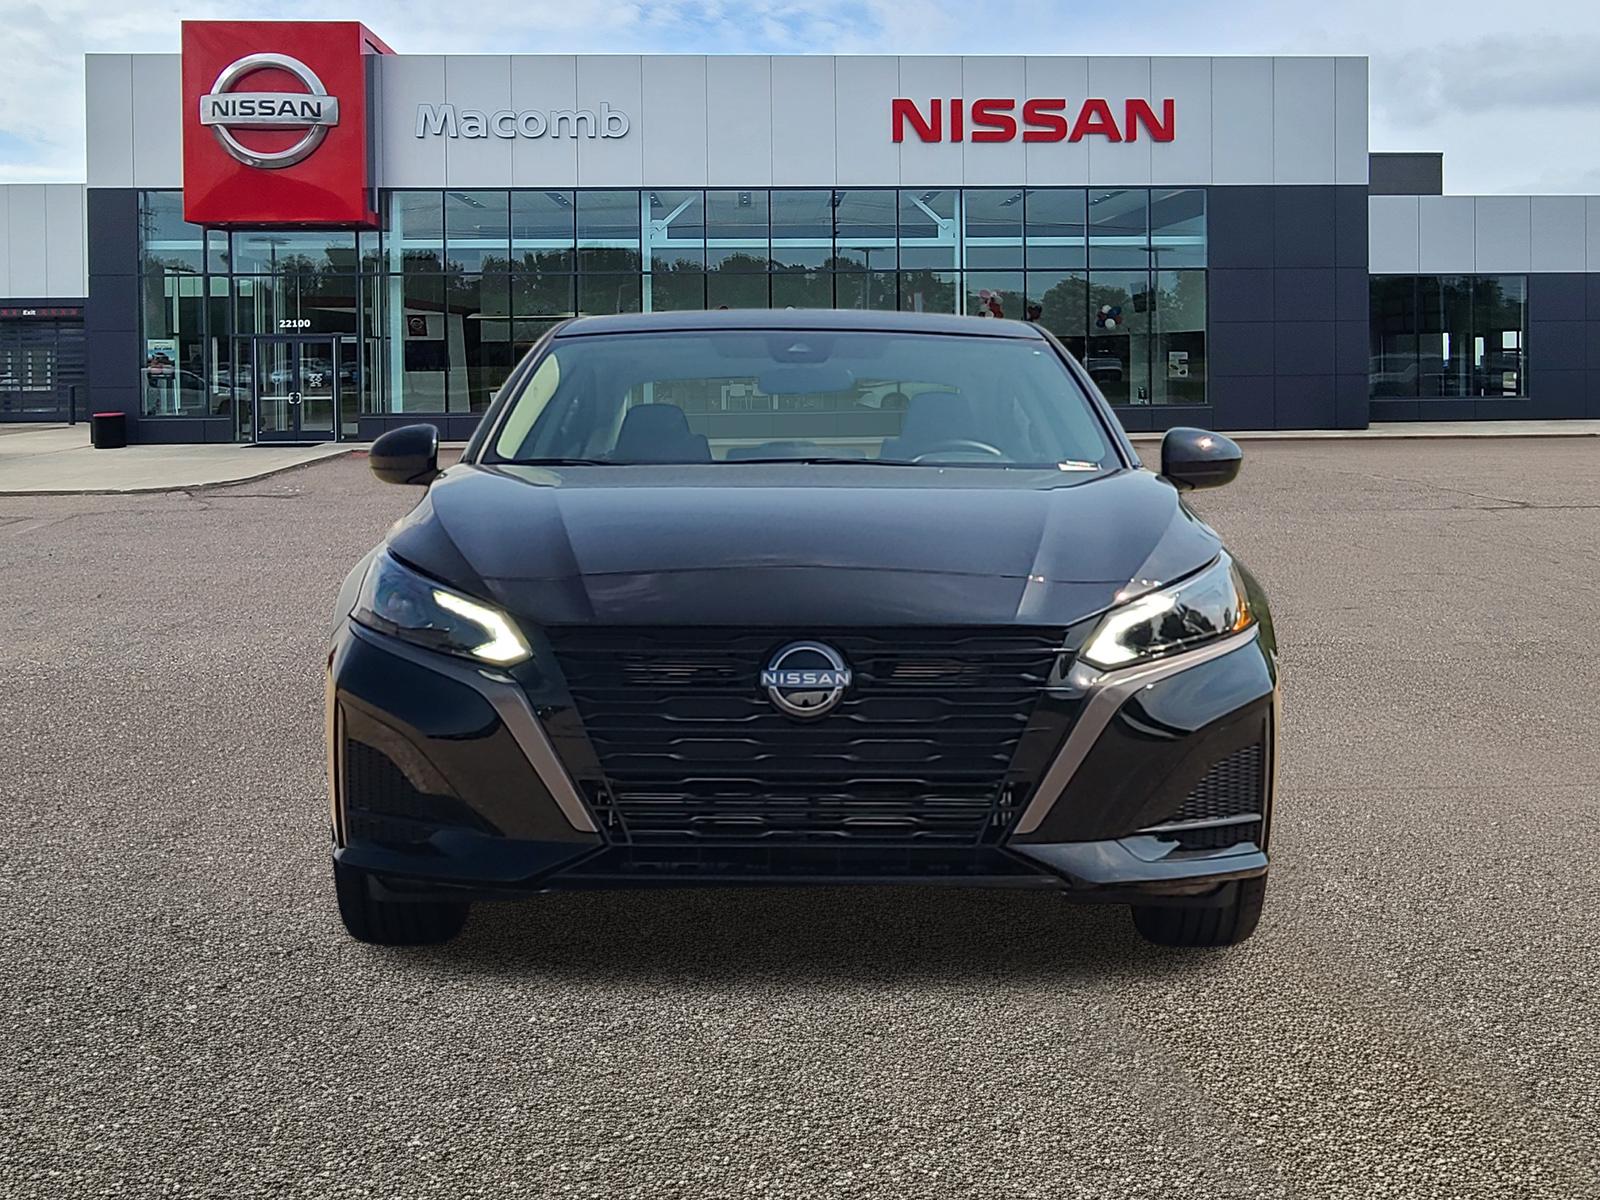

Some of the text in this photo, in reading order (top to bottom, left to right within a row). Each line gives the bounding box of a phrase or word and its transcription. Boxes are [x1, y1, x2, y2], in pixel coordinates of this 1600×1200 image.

[211, 100, 322, 117] NISSAN
[415, 102, 630, 138] Macomb
[892, 98, 1175, 143] NISSAN
[279, 319, 311, 328] 22100
[762, 672, 849, 685] NISSAN
